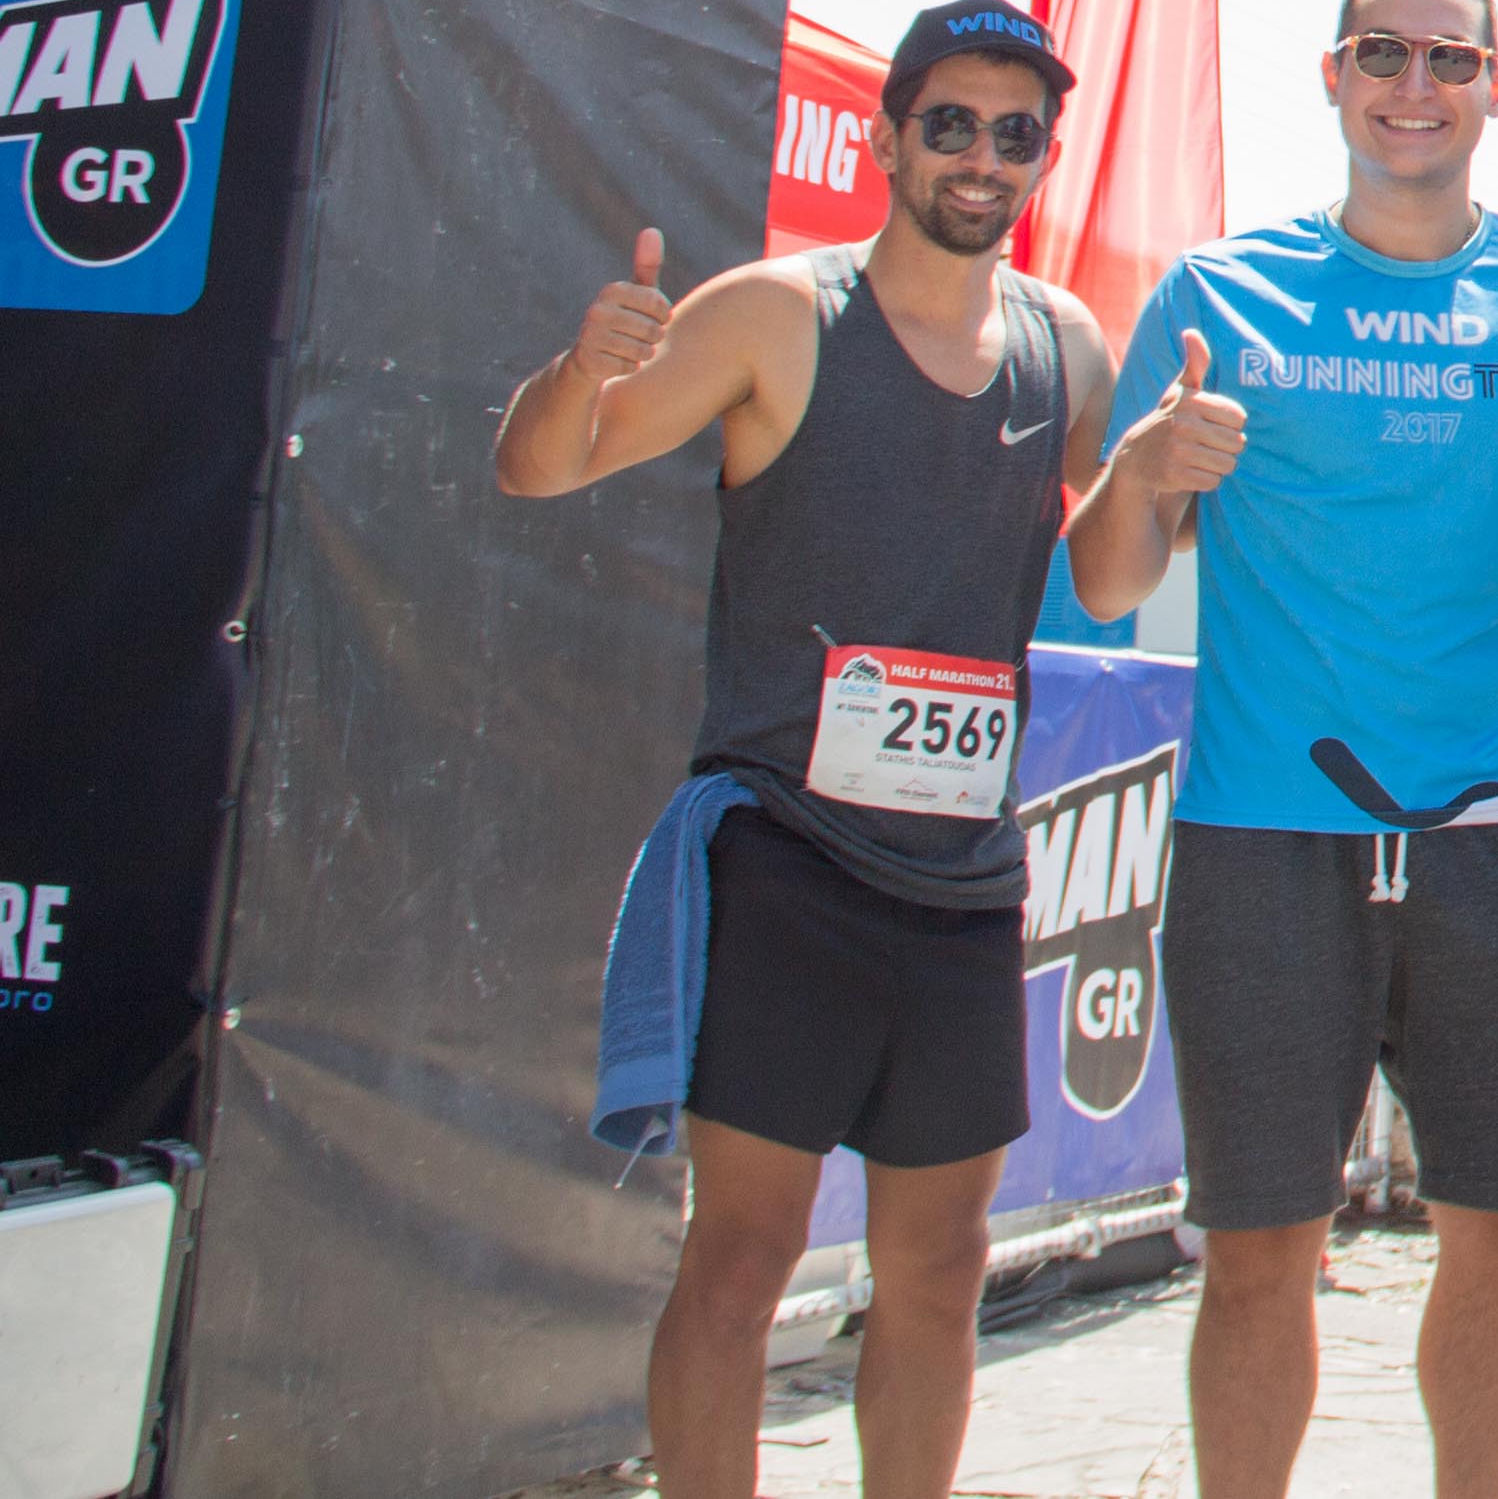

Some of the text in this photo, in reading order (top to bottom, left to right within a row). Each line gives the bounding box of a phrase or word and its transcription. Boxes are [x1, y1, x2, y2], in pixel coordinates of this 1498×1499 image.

[946, 10, 1043, 48] WIND
[59, 145, 156, 204] GR
[1344, 306, 1490, 346] WIND
[1379, 409, 1464, 444] 2017
[890, 663, 1011, 691] HALF MARATHON 21
[881, 697, 1007, 762] 2569
[1076, 967, 1144, 1041] GR
